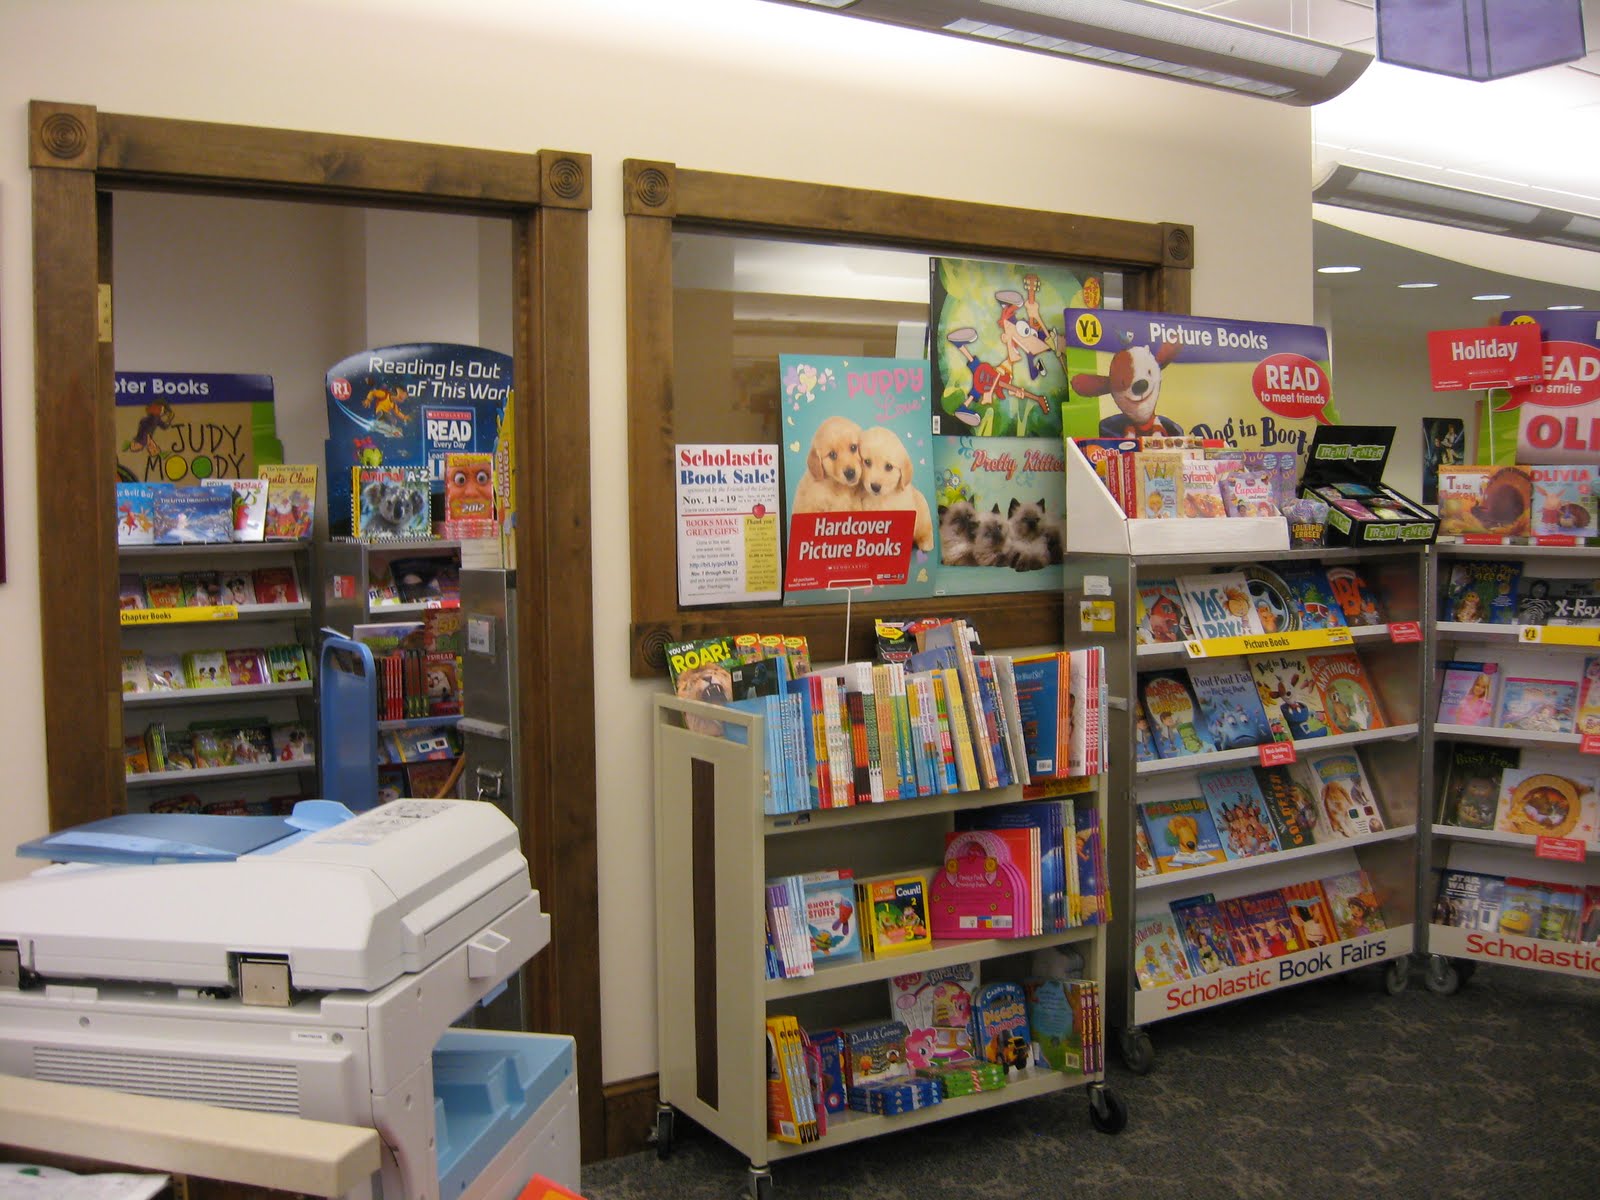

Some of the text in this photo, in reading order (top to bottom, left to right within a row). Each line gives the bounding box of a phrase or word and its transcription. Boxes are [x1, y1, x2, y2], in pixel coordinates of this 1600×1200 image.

[1079, 322, 1099, 339] Y1
[1149, 323, 1268, 350] Picture Books
[1451, 339, 1518, 362] Holiday
[369, 357, 501, 380] Reading Is Out
[1266, 363, 1320, 392] READ
[152, 378, 209, 396] Books
[333, 382, 350, 396] R1
[406, 382, 426, 397] of
[431, 381, 466, 399] This
[1546, 383, 1582, 394] smile
[1260, 393, 1325, 405] to meet friends
[427, 420, 472, 441] READ
[1189, 421, 1235, 448] Dog
[1240, 422, 1257, 438] in
[170, 424, 242, 455] JUDY
[433, 441, 467, 450] Every Day
[681, 449, 773, 466] Scholastic
[971, 448, 1018, 482] Pretty
[145, 454, 246, 483] MOODY
[360, 470, 430, 483] Animal A-Z
[1530, 469, 1590, 483] OLIVIA
[681, 469, 776, 485] Book Sale!
[1234, 481, 1268, 495] Cupcakes
[683, 496, 704, 505] Nov.
[707, 496, 718, 504] 14
[726, 496, 737, 504] 19
[686, 519, 714, 527] BOOKS
[815, 516, 892, 537] Hardcover
[686, 528, 713, 536] GREAT
[1294, 530, 1321, 540] ERASER
[799, 538, 902, 561] Picture Books
[121, 610, 172, 622] Chapter Books
[1555, 598, 1600, 618] X-Ray
[1202, 620, 1243, 638] DAY!
[1524, 629, 1536, 638] Y1
[668, 643, 695, 656] YOU CAN
[1244, 638, 1269, 649] Picture
[1269, 637, 1290, 647] Books
[671, 641, 731, 674] ROAR!
[1280, 657, 1306, 674] Boots
[1316, 661, 1360, 692] ANYTHING!
[1448, 874, 1481, 884] STAR
[896, 884, 922, 898] Count!
[885, 903, 890, 913] 1
[911, 898, 917, 906] 2
[807, 907, 836, 920] STUFFS
[904, 925, 914, 940] 3
[1167, 940, 1386, 1011] Scholastic Book Fairs
